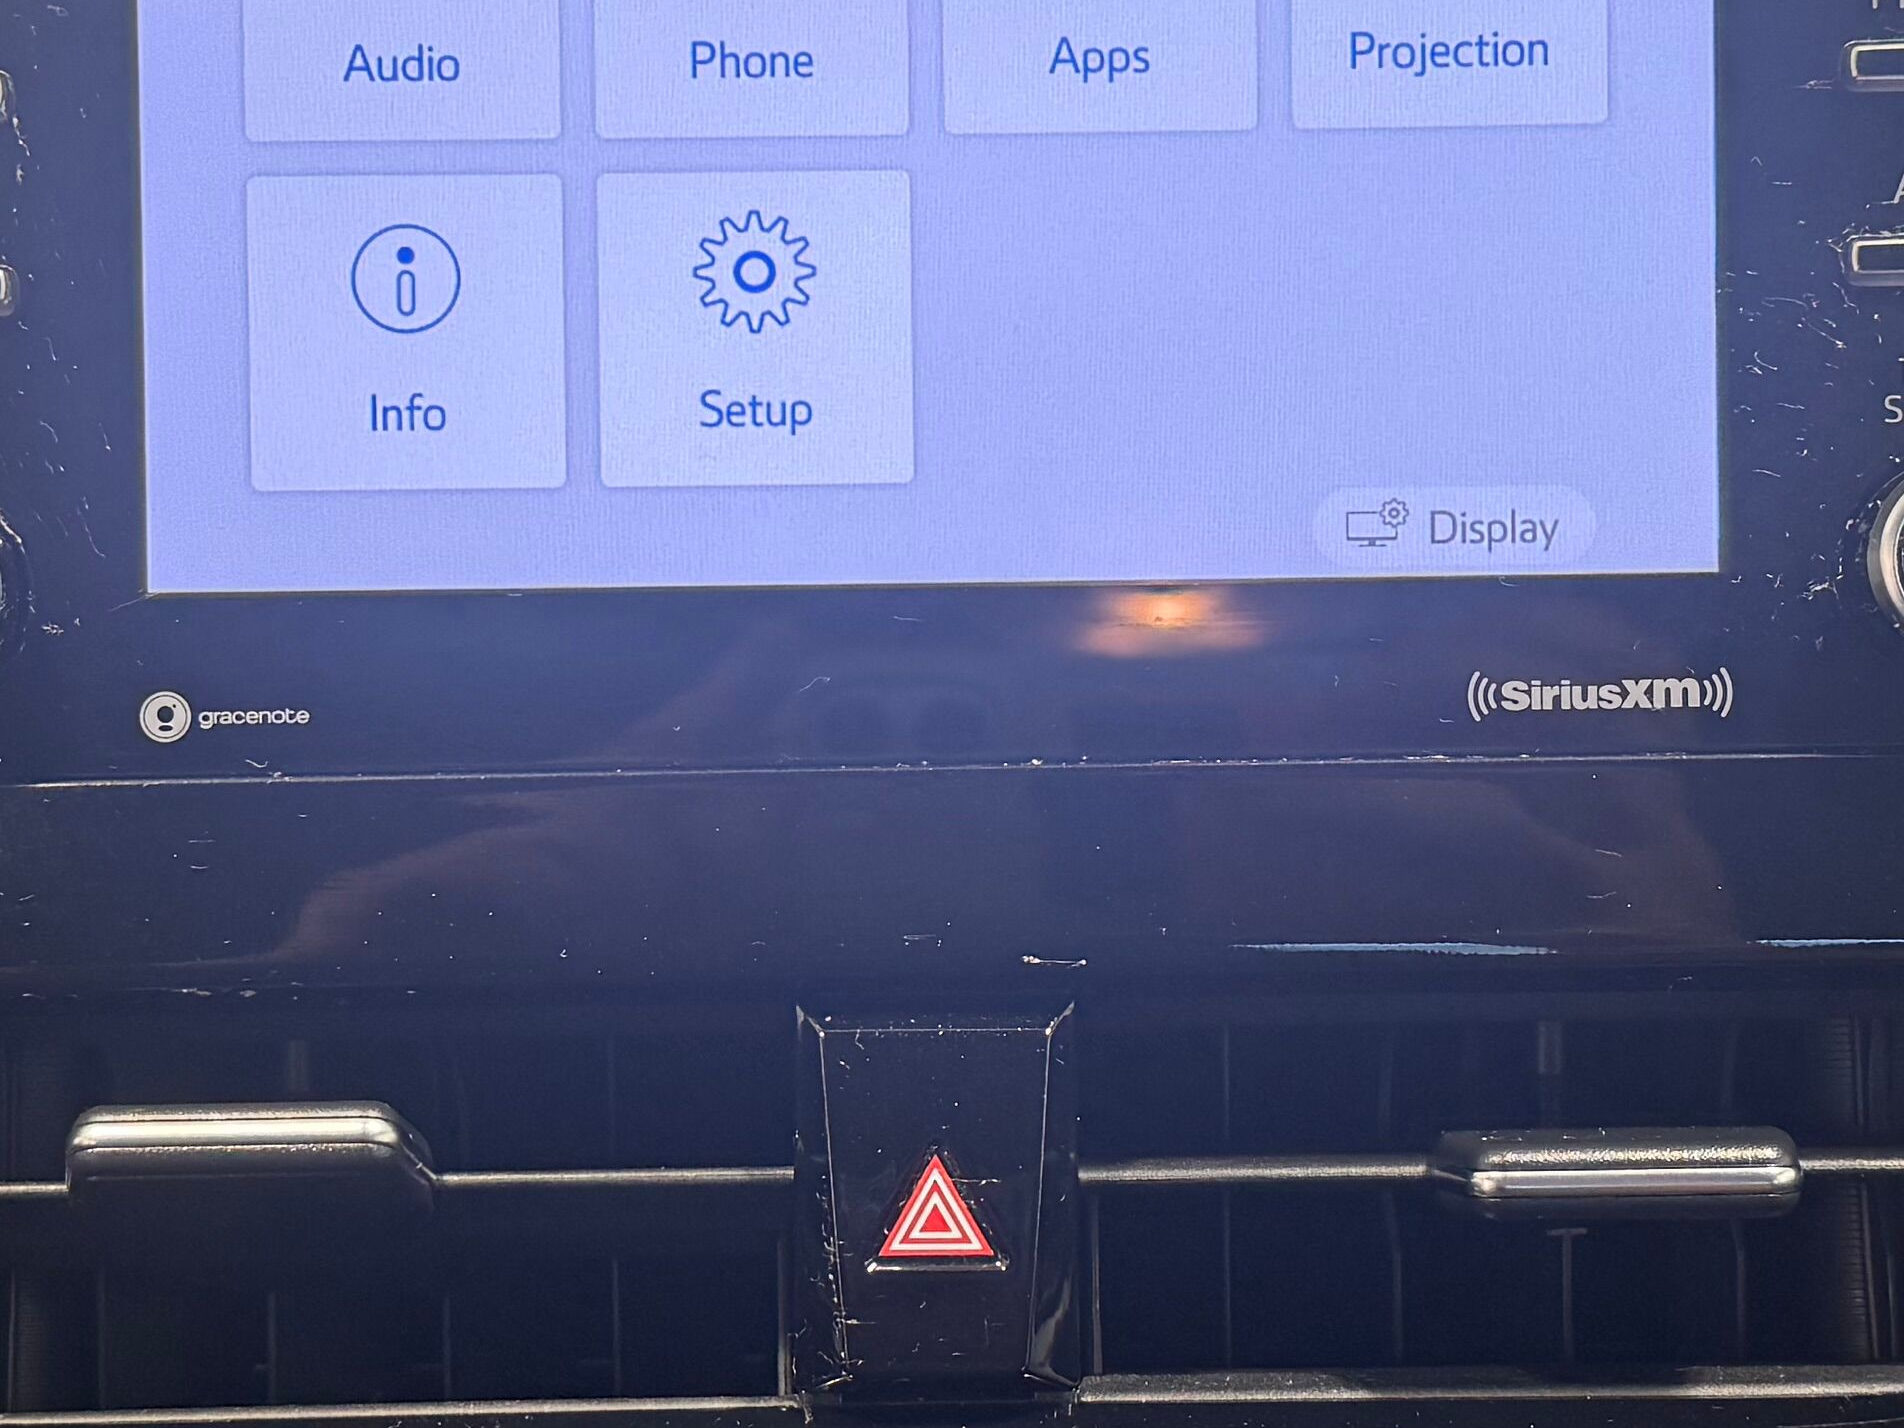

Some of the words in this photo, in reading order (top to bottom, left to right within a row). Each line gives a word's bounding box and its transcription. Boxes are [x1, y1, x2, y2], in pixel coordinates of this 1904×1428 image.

[343, 43, 461, 83] Audio
[689, 39, 815, 80] Phone
[1049, 37, 1151, 84] Apps
[1349, 31, 1551, 78] Projection
[369, 393, 447, 433] Info
[699, 389, 814, 437] Setup
[1429, 508, 1560, 553] Display
[198, 704, 310, 729] gracenote
